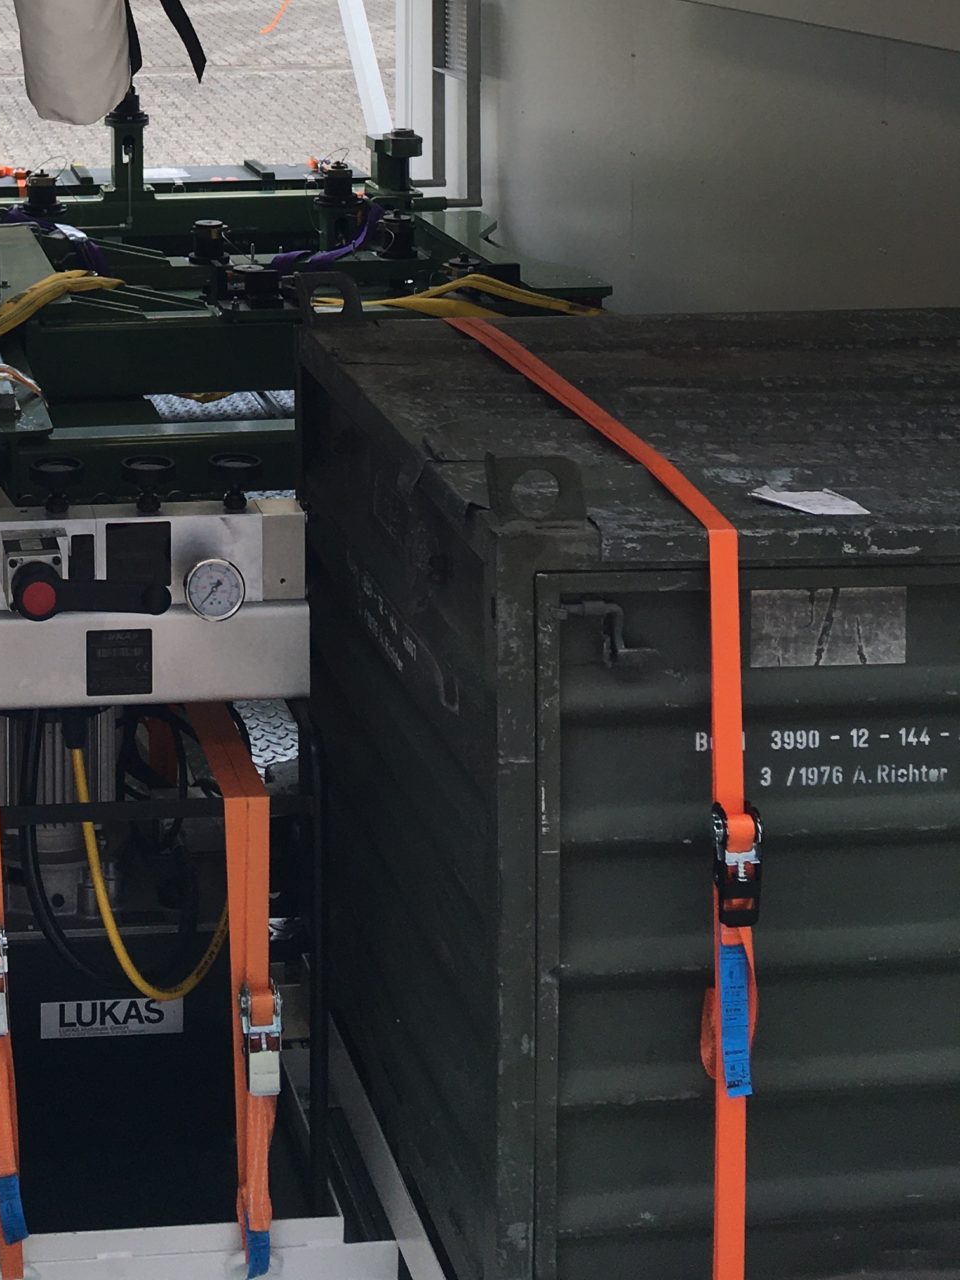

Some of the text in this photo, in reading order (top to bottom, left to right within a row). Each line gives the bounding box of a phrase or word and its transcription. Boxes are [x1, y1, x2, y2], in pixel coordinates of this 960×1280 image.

[770, 730, 820, 750] 3990
[850, 728, 869, 748] 12
[899, 726, 931, 746] 144
[58, 999, 165, 1027] LUKAS
